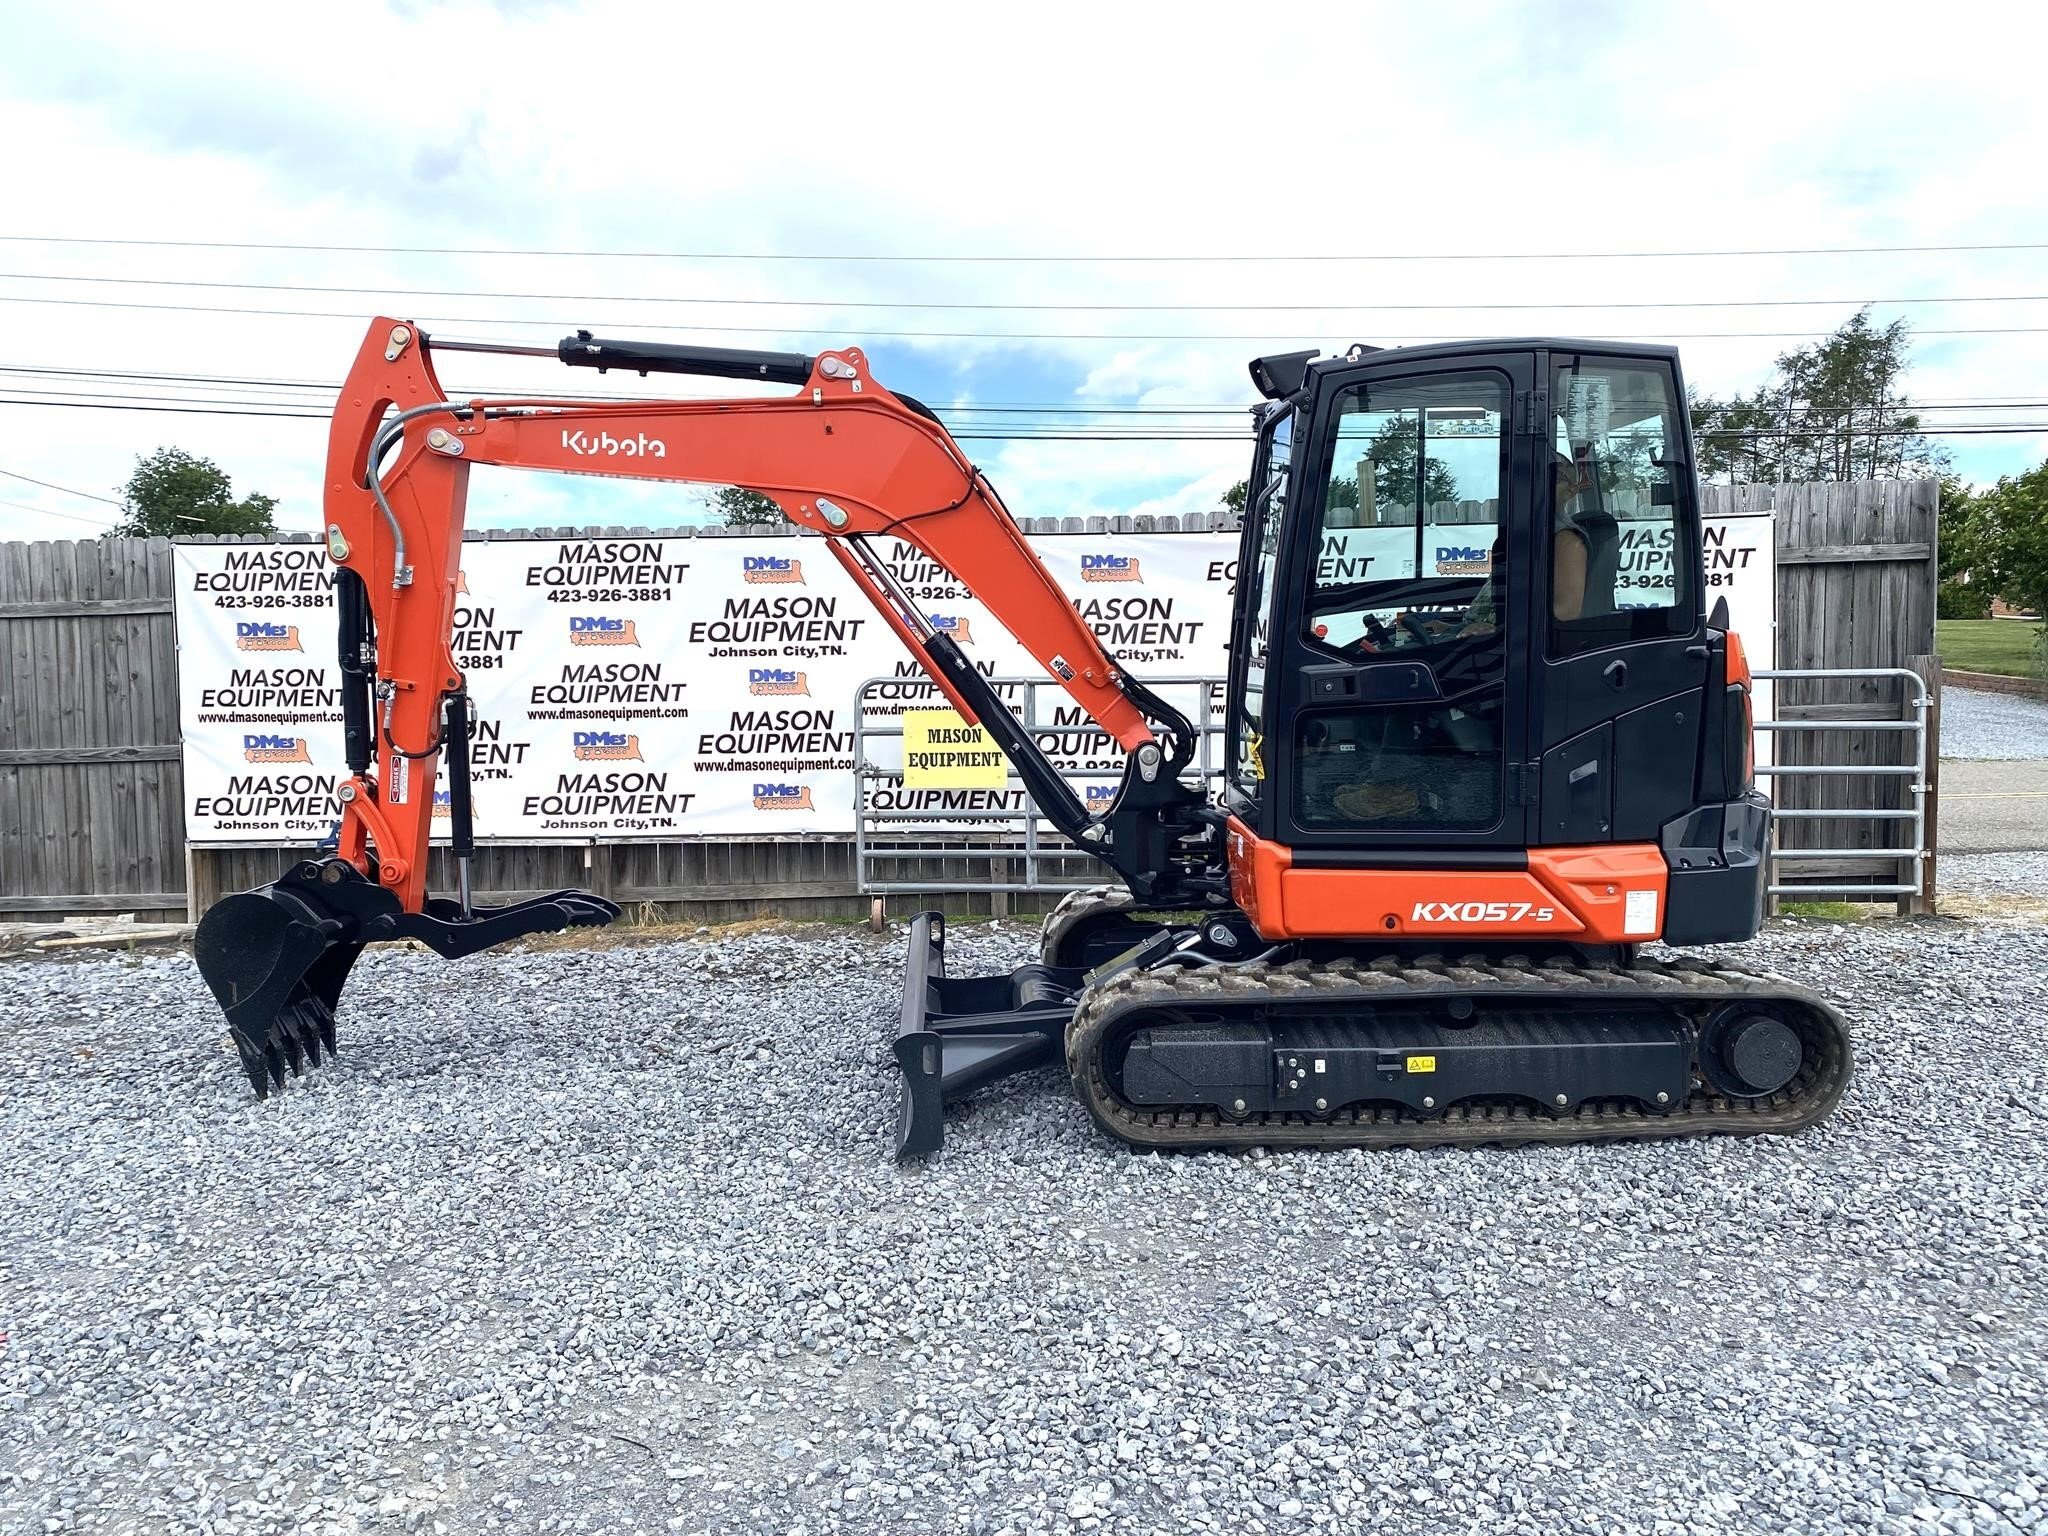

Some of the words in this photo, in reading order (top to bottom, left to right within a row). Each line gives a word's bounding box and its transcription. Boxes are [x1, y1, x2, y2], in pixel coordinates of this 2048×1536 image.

[561, 430, 666, 458] Kubota
[224, 551, 326, 571] MASON
[559, 544, 662, 564] MASON
[193, 573, 334, 592] EQUIPMEN
[526, 565, 689, 585] EQUIPMENT
[215, 595, 334, 608] 423-926-3881
[548, 589, 670, 602] 423-926-3881
[724, 598, 836, 618] MASON
[689, 620, 864, 642] EQUIPMENT
[709, 647, 777, 657] Johnson
[783, 646, 846, 658] City,TN.
[1116, 649, 1184, 662] City,TN.
[231, 669, 324, 687] MASON
[562, 664, 661, 683] MASON
[531, 684, 686, 703] EQUIPMENT
[198, 711, 344, 725] www.dmasonequipment.co
[528, 707, 688, 721] www.dmasonequipment.com
[730, 711, 834, 731] MASON
[928, 729, 982, 743] MASON
[909, 752, 1002, 770] EQUIPMENT
[228, 775, 335, 796] MASON
[557, 773, 667, 793] MASON
[194, 797, 344, 816] EQUIPMEN
[523, 794, 695, 815] EQUIPMENT
[214, 820, 279, 829] Johnson
[541, 820, 607, 828] Johnson
[614, 818, 676, 829] City,TN.
[1411, 902, 1554, 922] KX057-5
